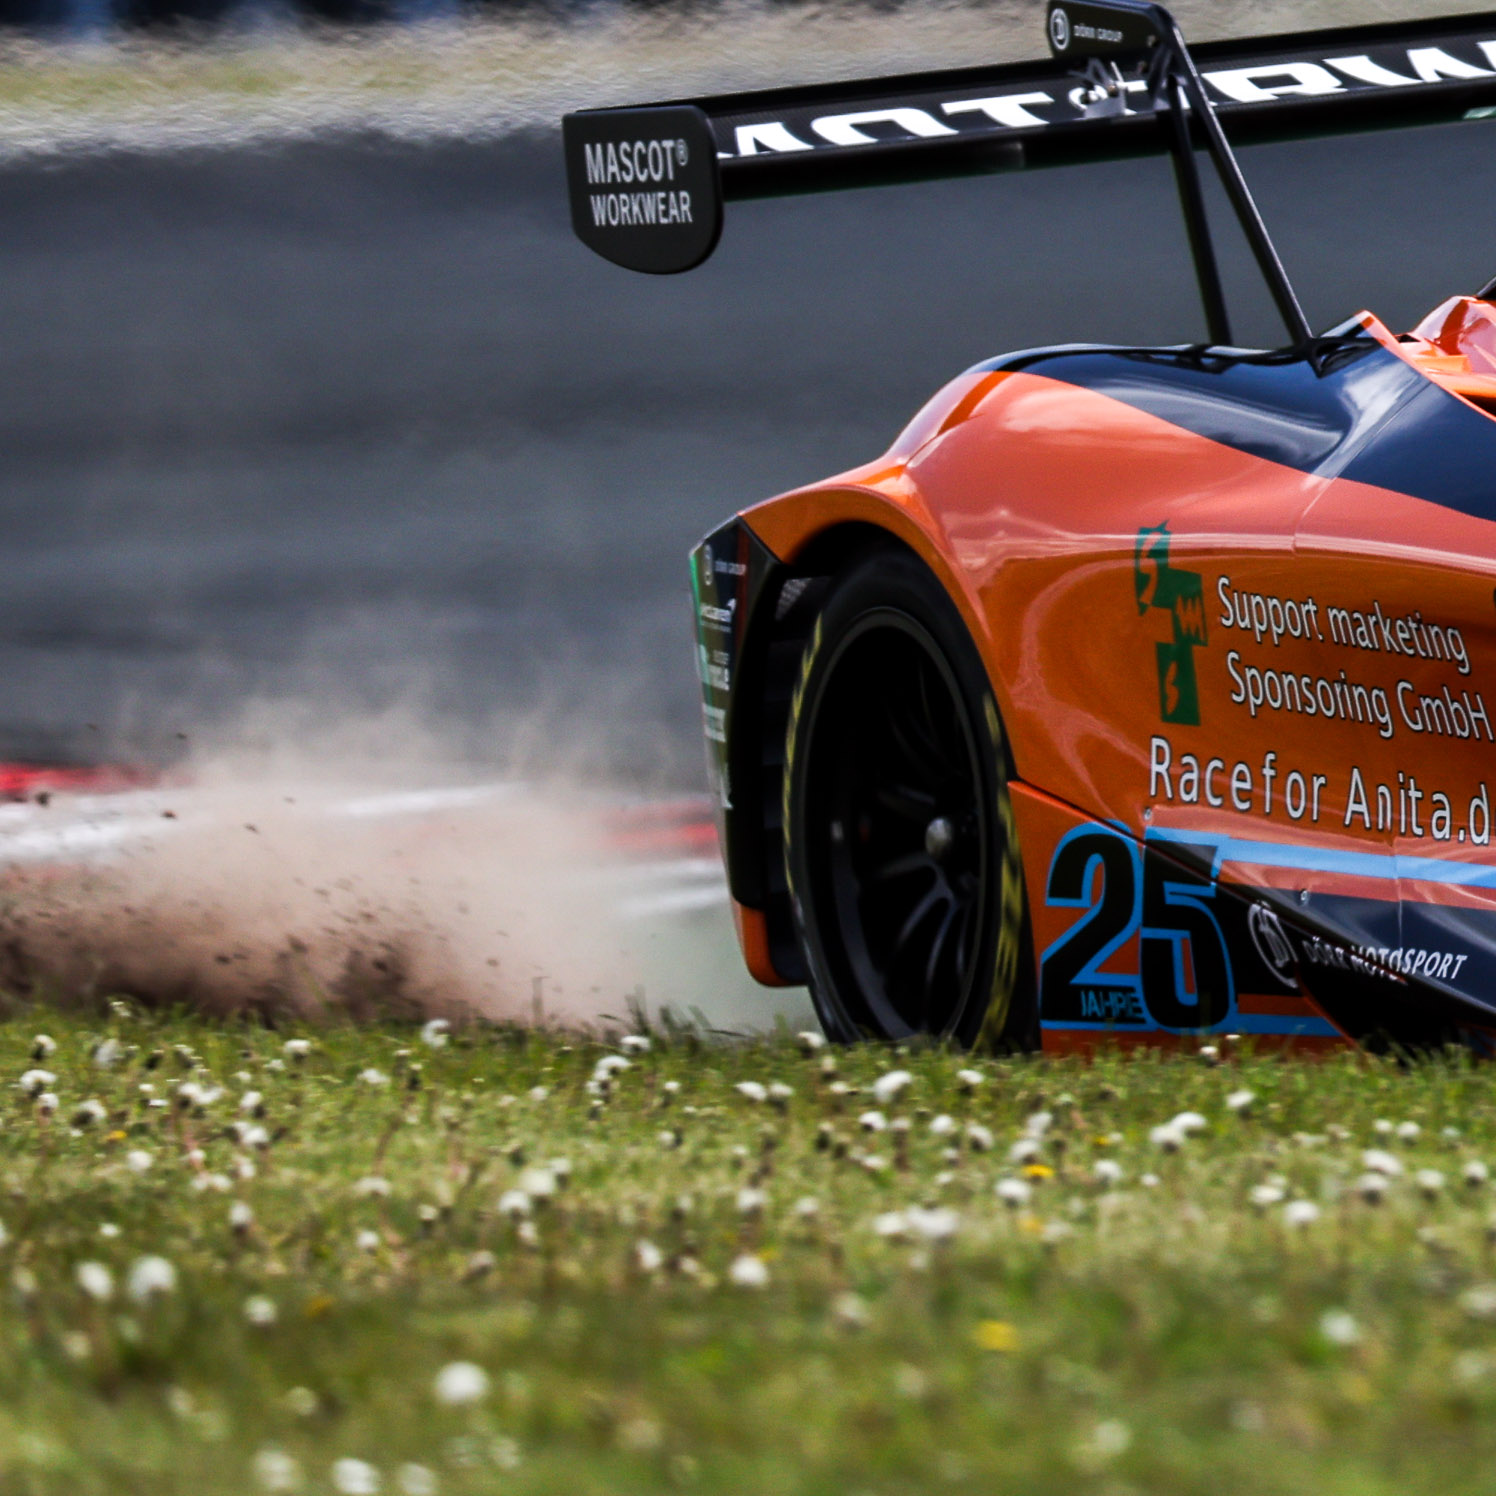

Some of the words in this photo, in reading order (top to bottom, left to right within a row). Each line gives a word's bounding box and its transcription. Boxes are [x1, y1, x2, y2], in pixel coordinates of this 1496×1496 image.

[590, 190, 693, 226] WORKWEAR
[1217, 576, 1323, 646] Support
[1328, 601, 1471, 674] marketing
[1226, 652, 1394, 739] Sponsoring
[1397, 681, 1496, 742] GmbH
[1040, 819, 1238, 1034] 25
